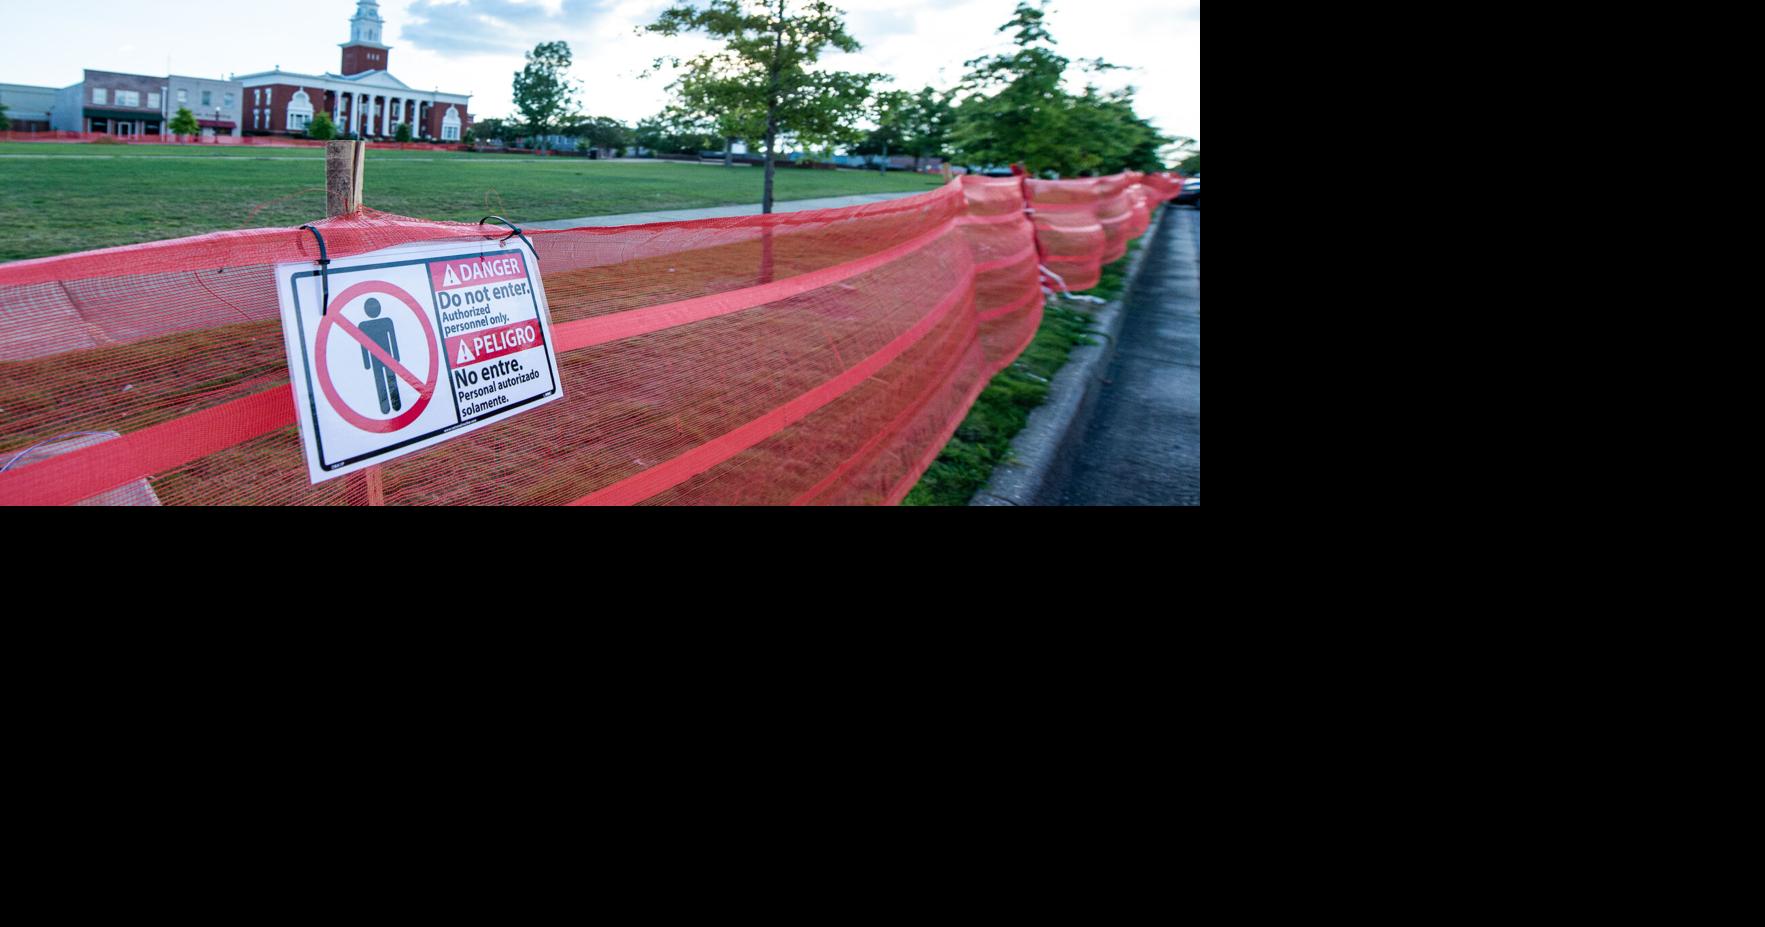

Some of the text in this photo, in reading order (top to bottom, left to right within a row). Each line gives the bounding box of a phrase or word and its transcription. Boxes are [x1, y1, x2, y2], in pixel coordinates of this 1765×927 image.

[459, 257, 521, 281] DANGER
[437, 282, 530, 310] Do not enter.
[442, 304, 491, 323] Authorized
[444, 312, 510, 337] personnel only.
[473, 325, 536, 357] PELIGRO
[454, 359, 523, 389] No entre.
[458, 369, 540, 402] Personal autorizado
[461, 395, 509, 417] solamente.
